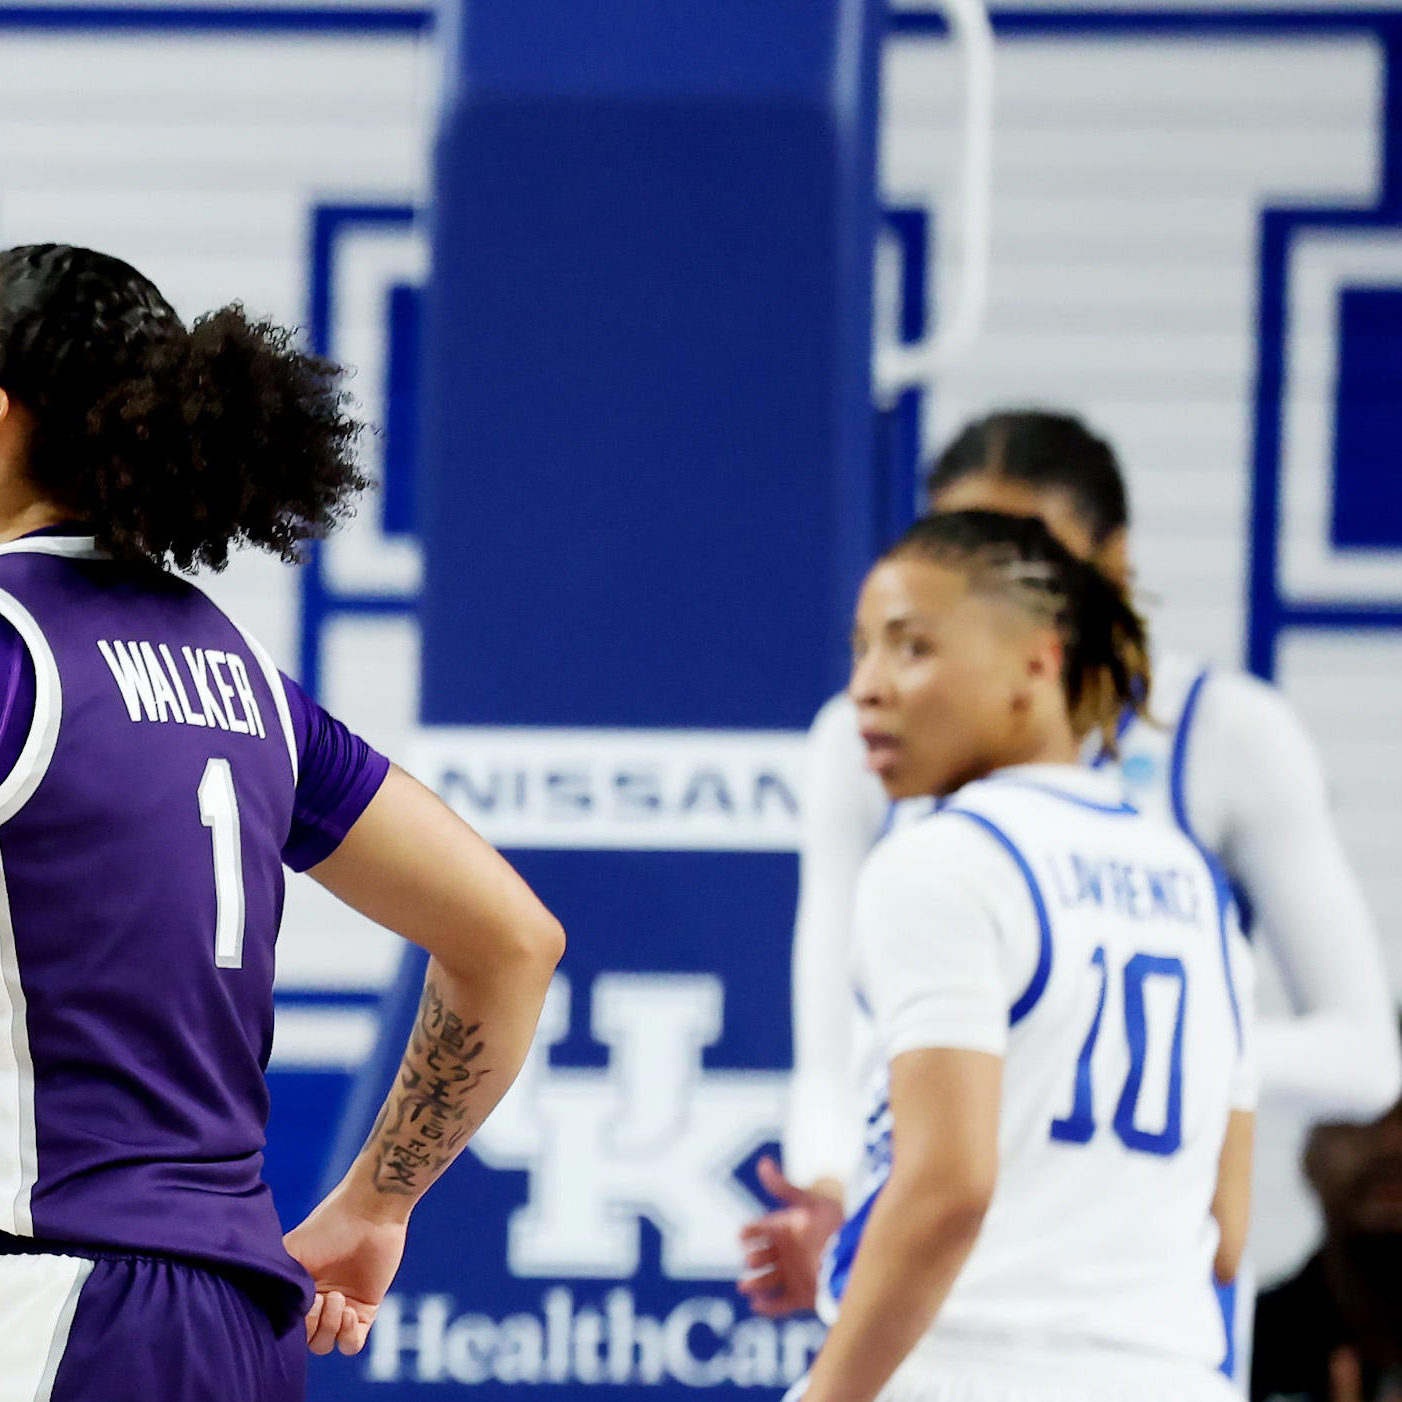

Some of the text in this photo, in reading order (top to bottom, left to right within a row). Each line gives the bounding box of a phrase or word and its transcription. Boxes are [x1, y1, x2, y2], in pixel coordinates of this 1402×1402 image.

[96, 639, 266, 739] WALKER
[442, 766, 802, 820] NISSAN
[197, 757, 246, 969] 1
[1049, 945, 1187, 1156] 10
[368, 1287, 828, 1387] HealthCar
